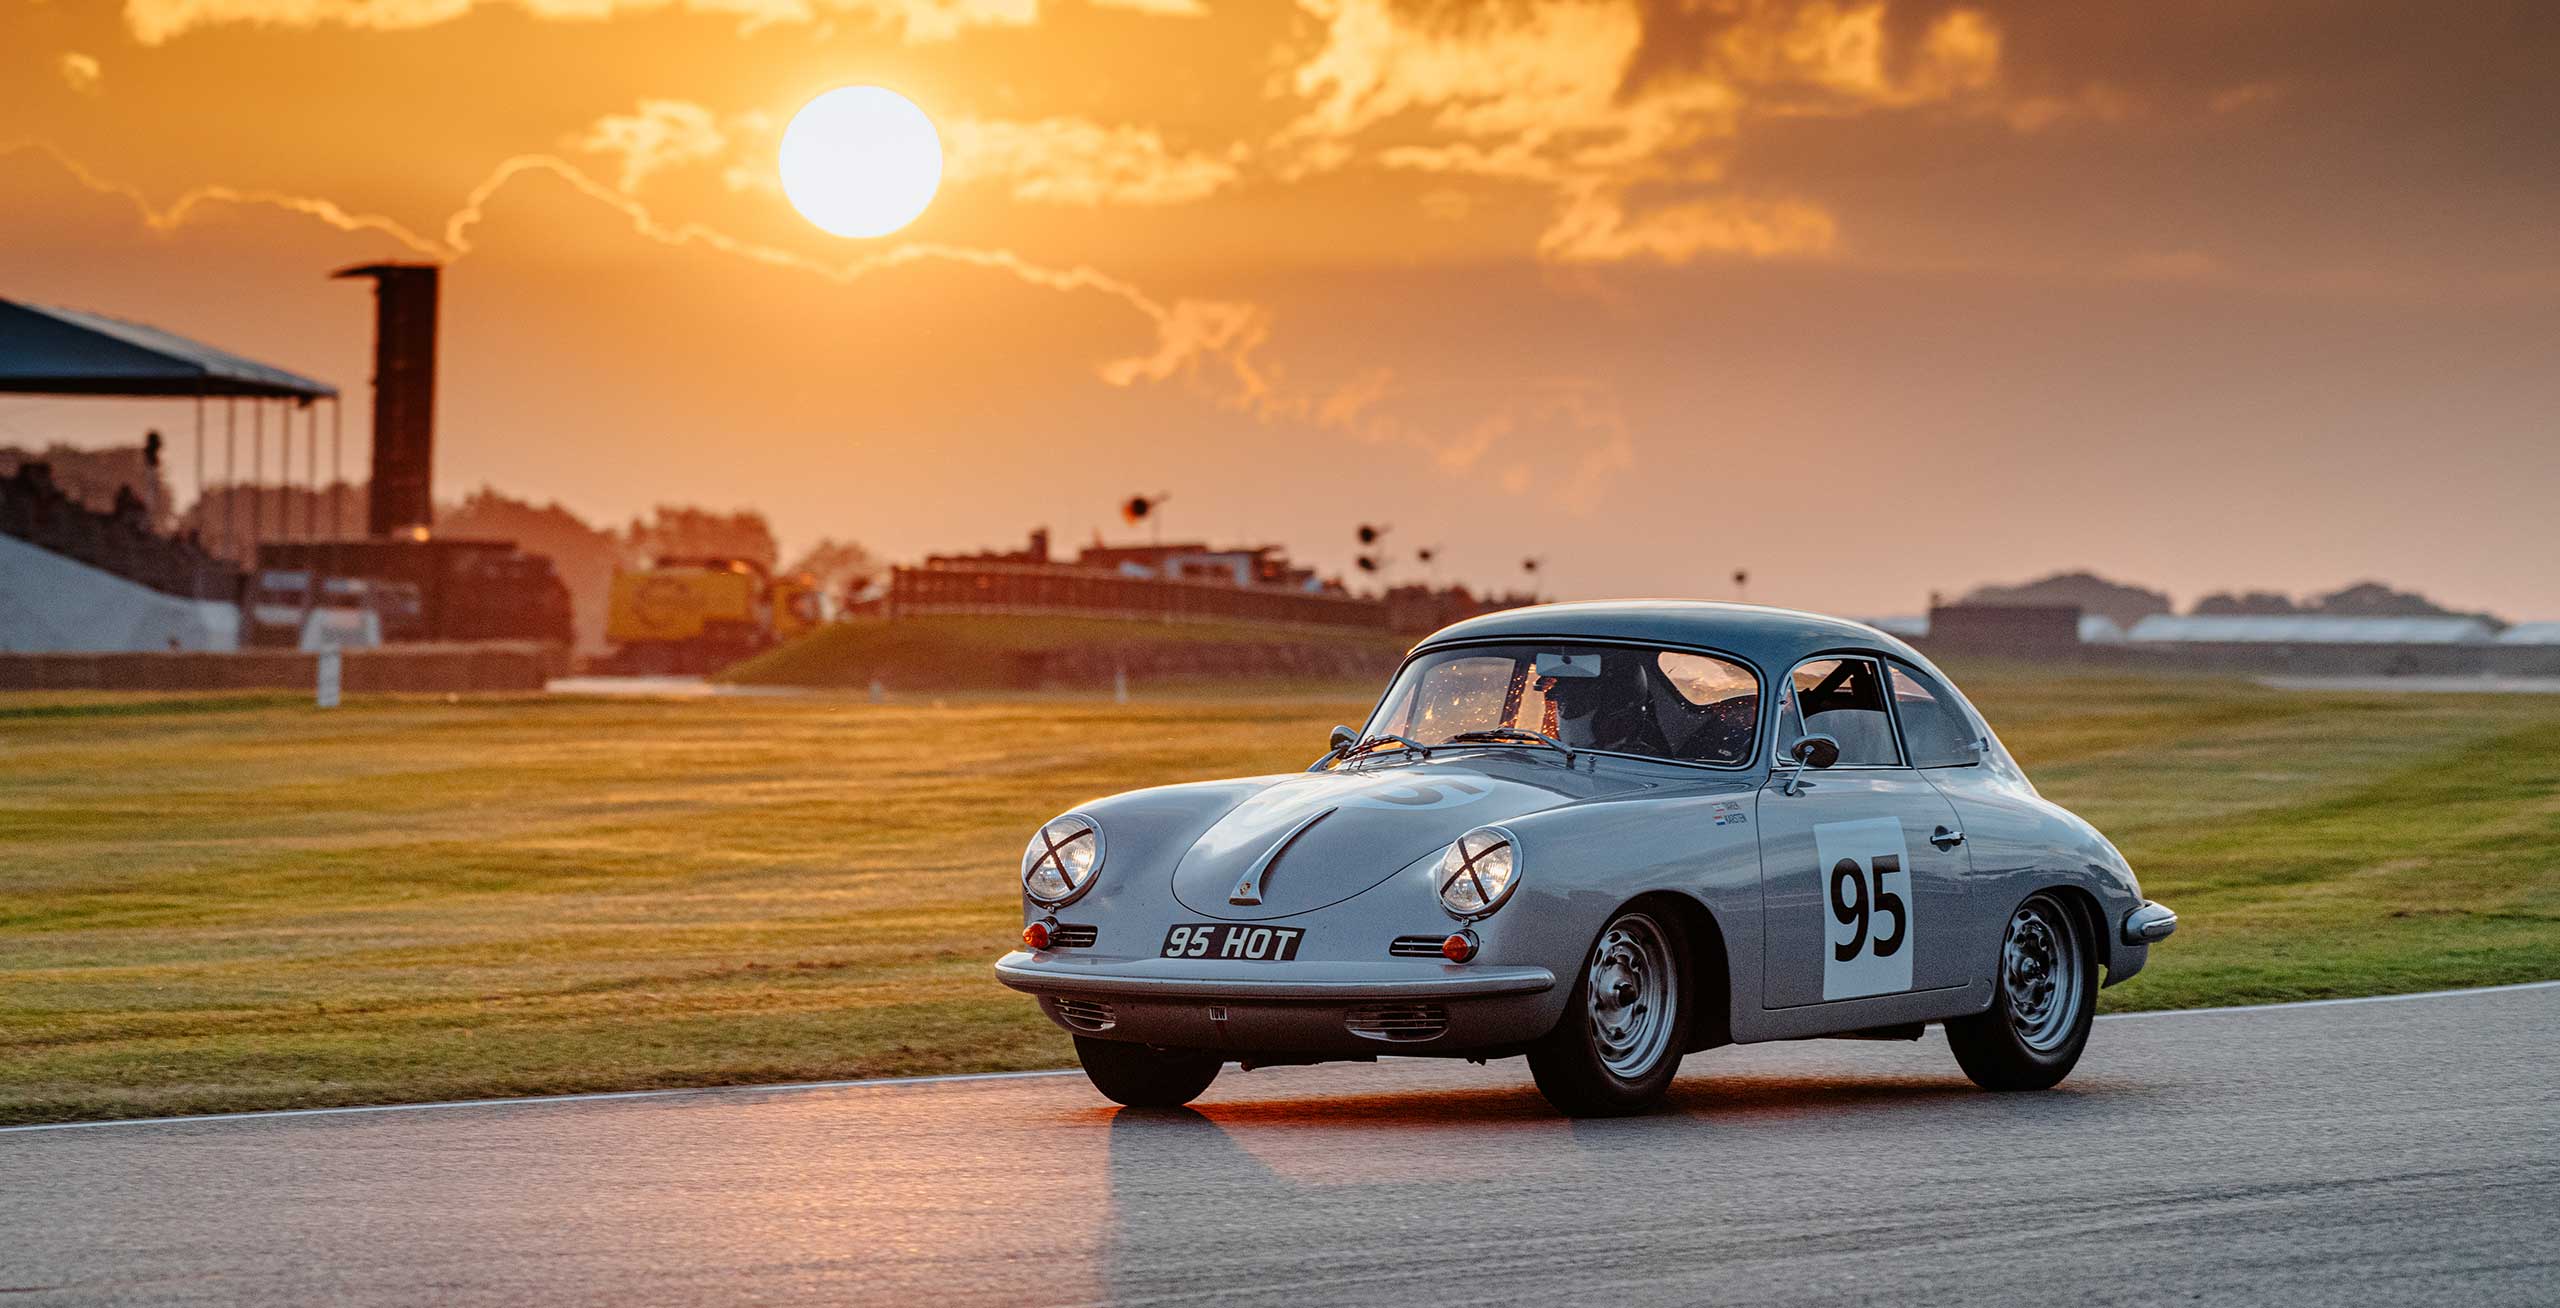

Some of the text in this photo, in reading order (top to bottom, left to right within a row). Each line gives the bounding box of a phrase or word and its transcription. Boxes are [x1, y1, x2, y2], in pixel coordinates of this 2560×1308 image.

[1830, 854, 1906, 962] 95
[1166, 927, 1298, 961] 95 HOT
